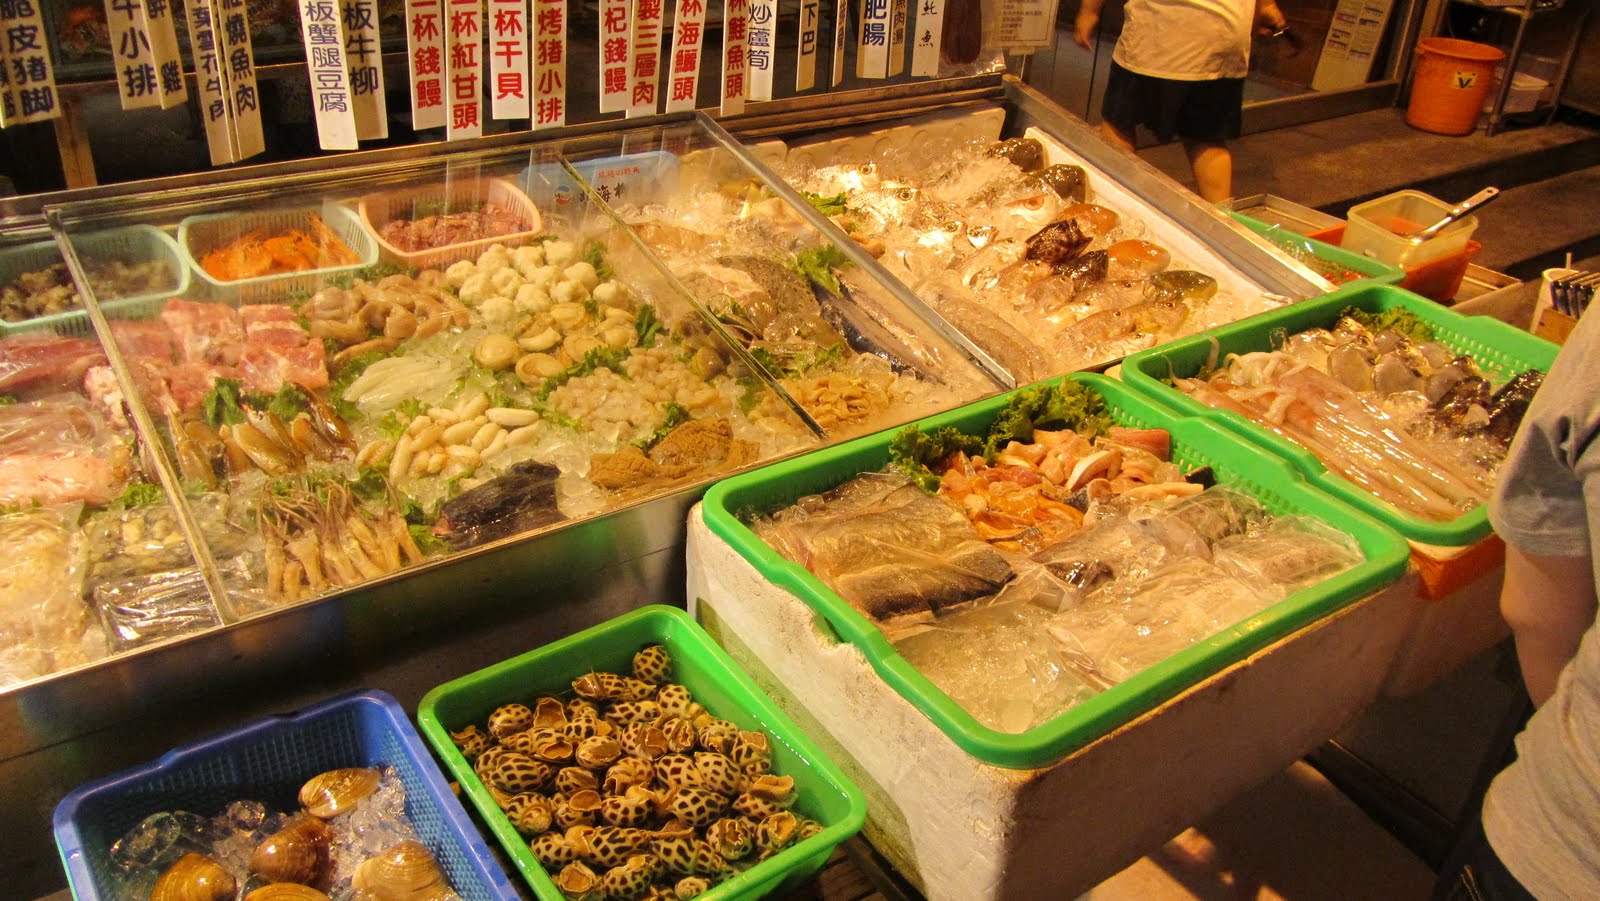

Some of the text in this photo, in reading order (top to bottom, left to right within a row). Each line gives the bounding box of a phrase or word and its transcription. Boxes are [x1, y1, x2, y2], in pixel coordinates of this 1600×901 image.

[304, 1, 348, 113] 板蟹腿豆腐
[343, 1, 379, 96] 板牛柳
[537, 0, 563, 125] 烤猪小排
[604, 0, 628, 95] 杞錢鰻
[746, 0, 774, 71] 炒蘆筍
[801, 3, 818, 56] 下巴
[862, 0, 888, 46] 肥腸
